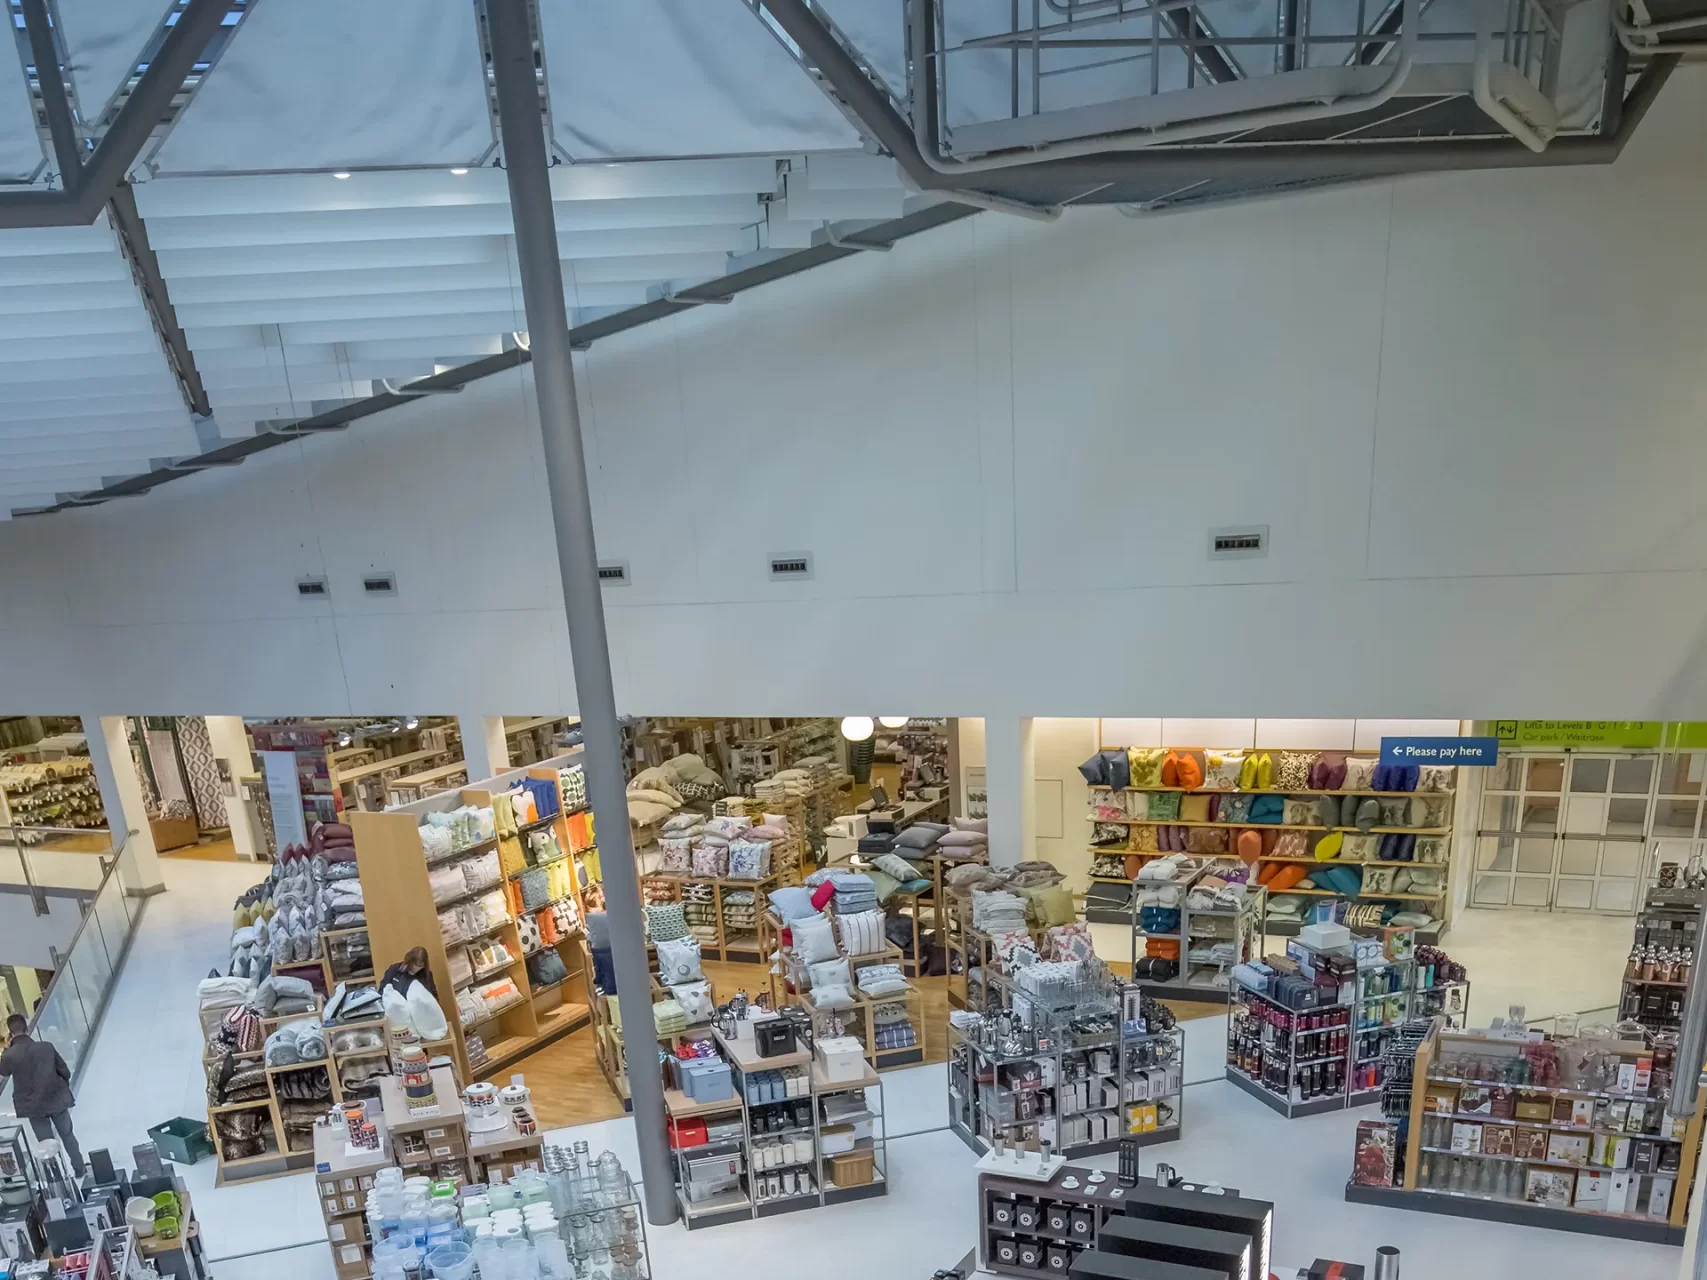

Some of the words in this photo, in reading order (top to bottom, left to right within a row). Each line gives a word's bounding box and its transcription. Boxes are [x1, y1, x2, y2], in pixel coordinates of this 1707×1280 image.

[1524, 721, 1542, 730] Lifts
[1545, 722, 1555, 730] to
[1557, 721, 1583, 730] Levels
[1586, 721, 1592, 730] B
[1598, 721, 1606, 730] G
[1625, 721, 1631, 730] 2
[1638, 721, 1644, 730] 3
[1523, 732, 1538, 741] Car
[1540, 732, 1558, 742] park
[1567, 732, 1605, 742] Waitrose
[1406, 746, 1437, 756] Please
[1440, 748, 1457, 759] pay
[1459, 746, 1483, 756] here
